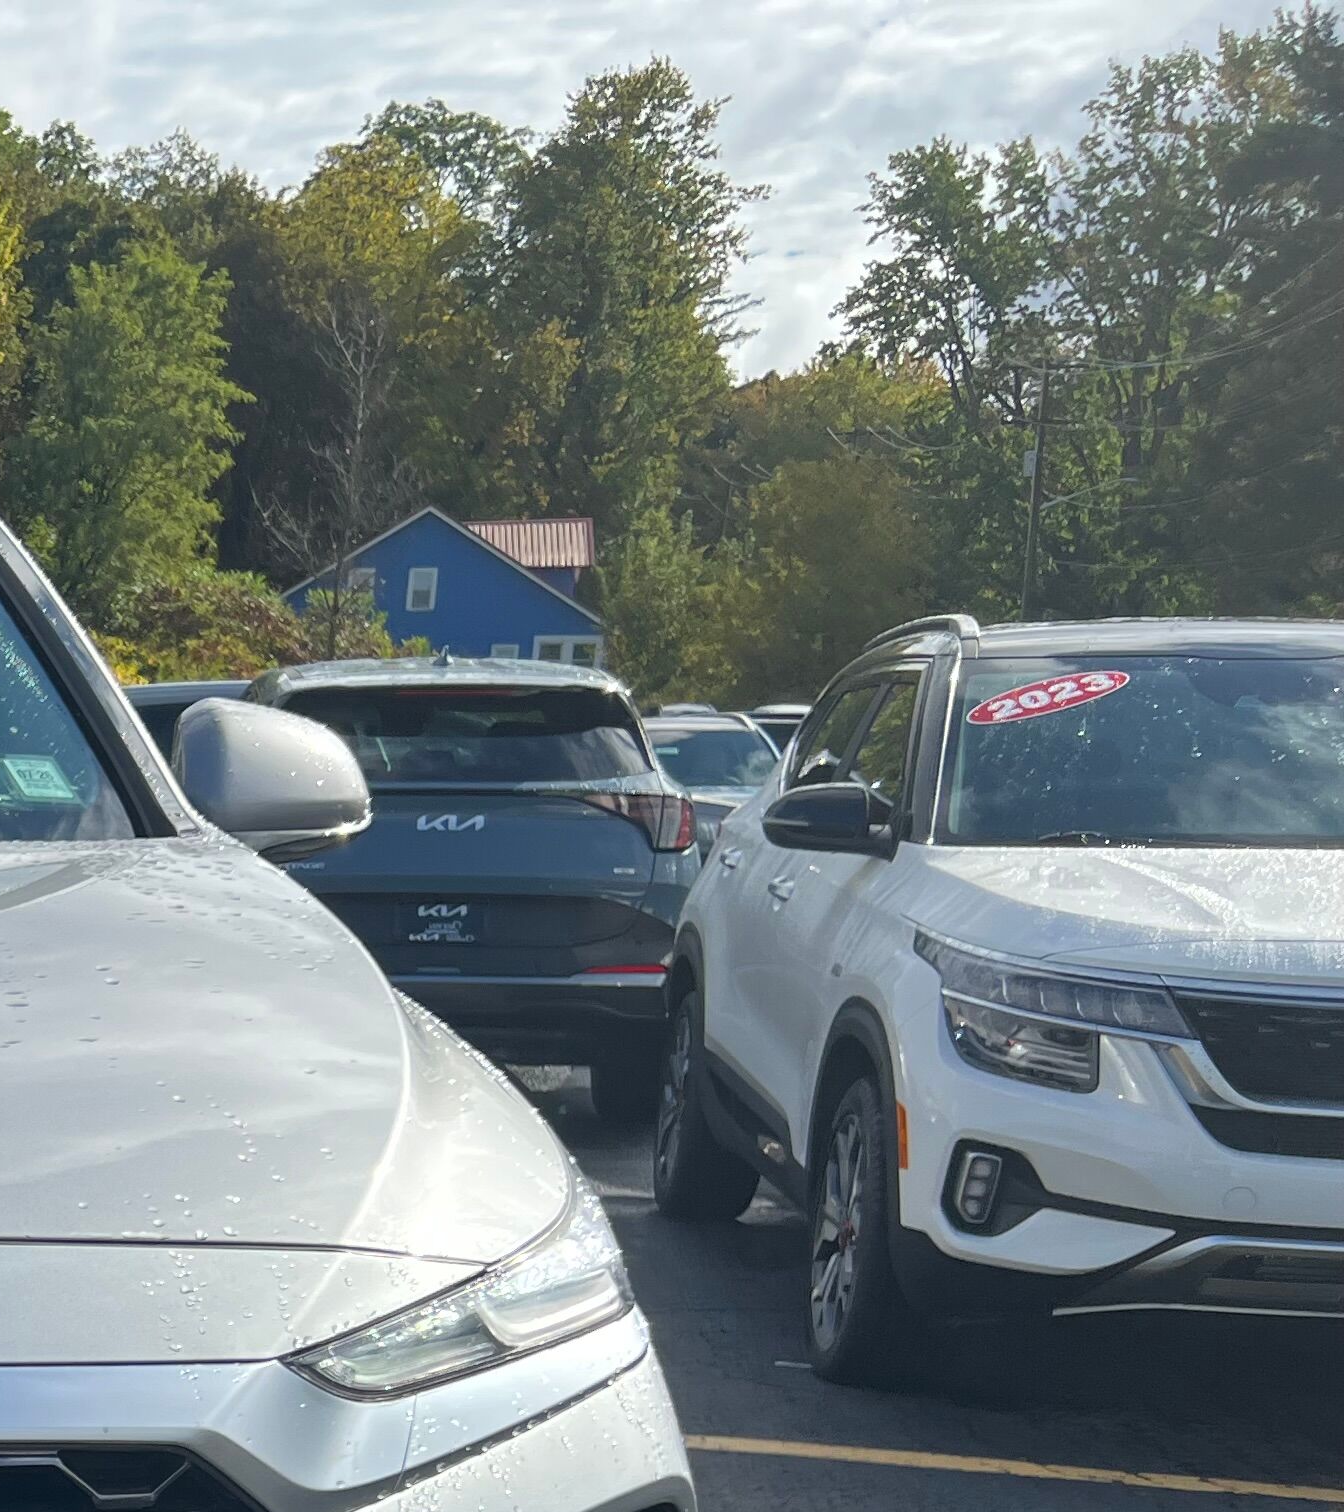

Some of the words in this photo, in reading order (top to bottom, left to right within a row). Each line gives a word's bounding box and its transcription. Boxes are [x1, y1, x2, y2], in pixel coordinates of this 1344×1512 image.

[987, 673, 1115, 722] 2023
[416, 814, 485, 832] KIA
[417, 904, 468, 917] KIA
